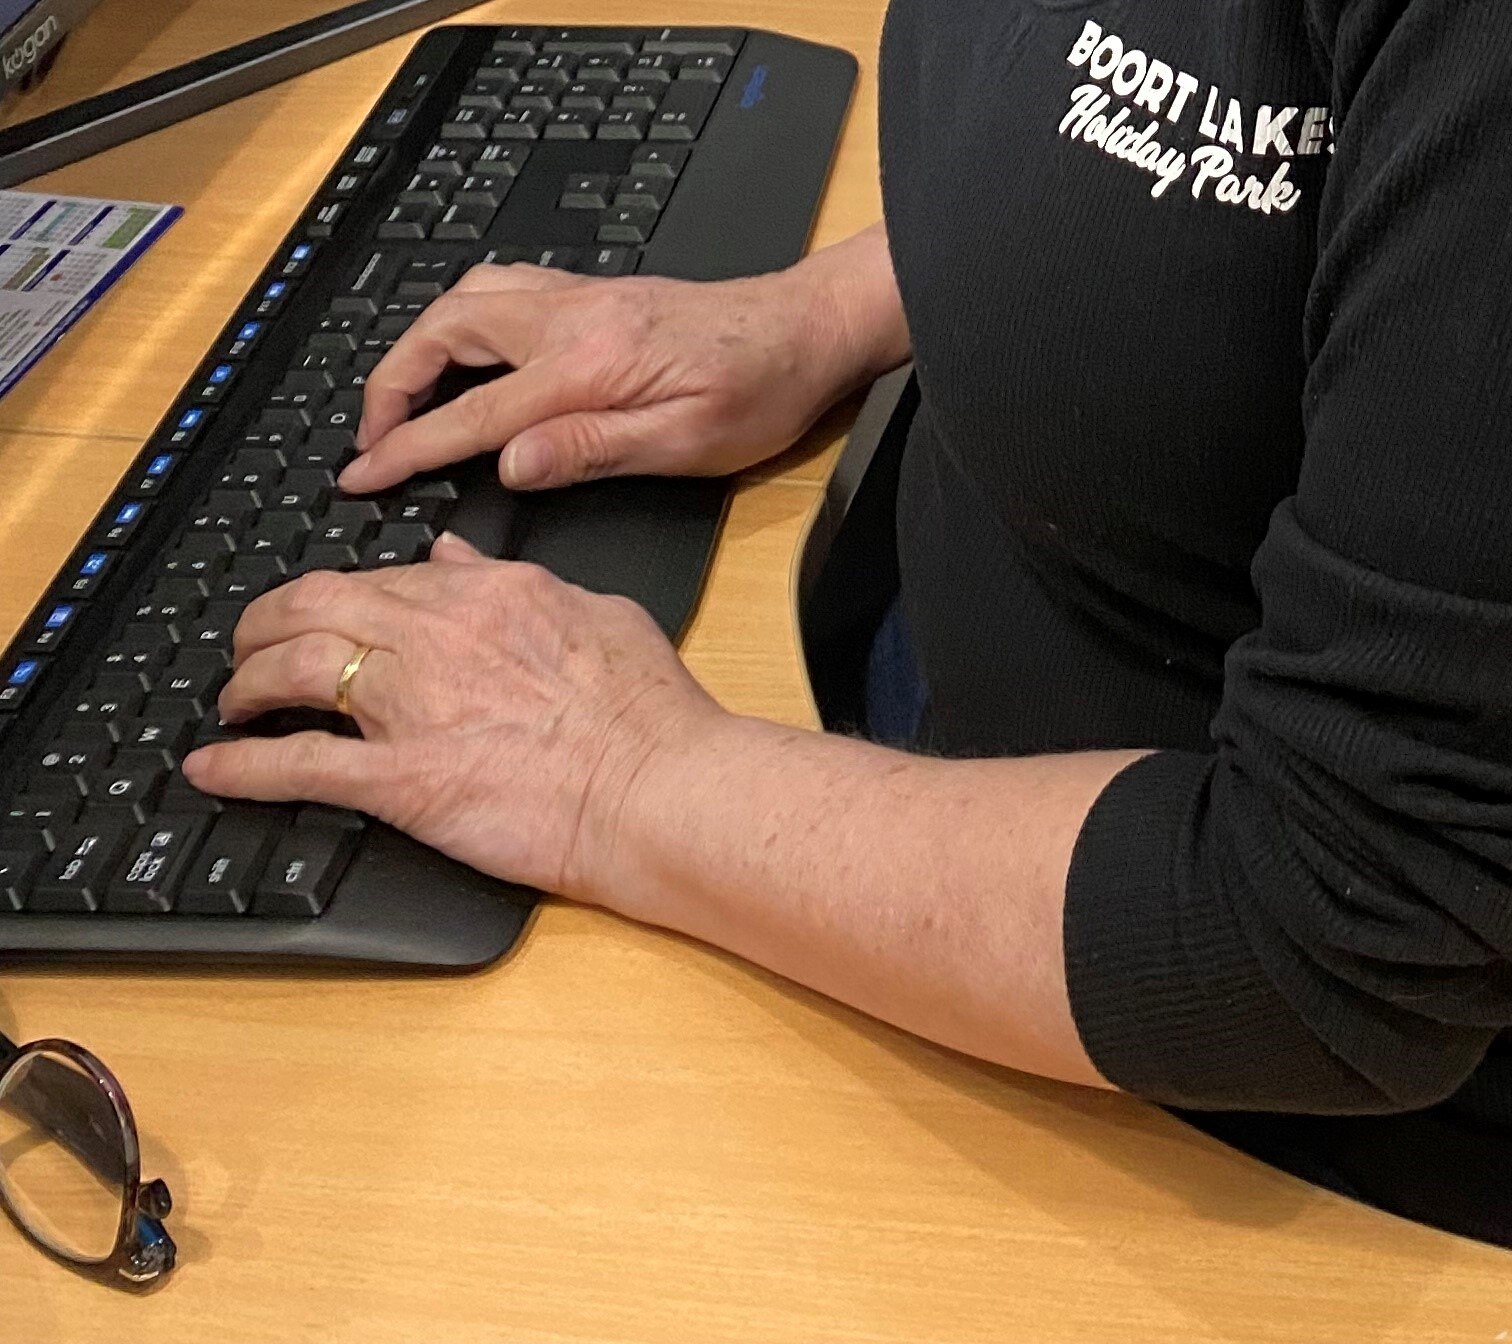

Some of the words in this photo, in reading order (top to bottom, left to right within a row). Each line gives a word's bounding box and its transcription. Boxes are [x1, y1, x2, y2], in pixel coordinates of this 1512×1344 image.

[3, 15, 57, 78] kogan
[1066, 20, 1199, 124] BOORT
[1059, 83, 1187, 198] Holiday
[1190, 145, 1301, 214] Park
[109, 780, 132, 794] Q
